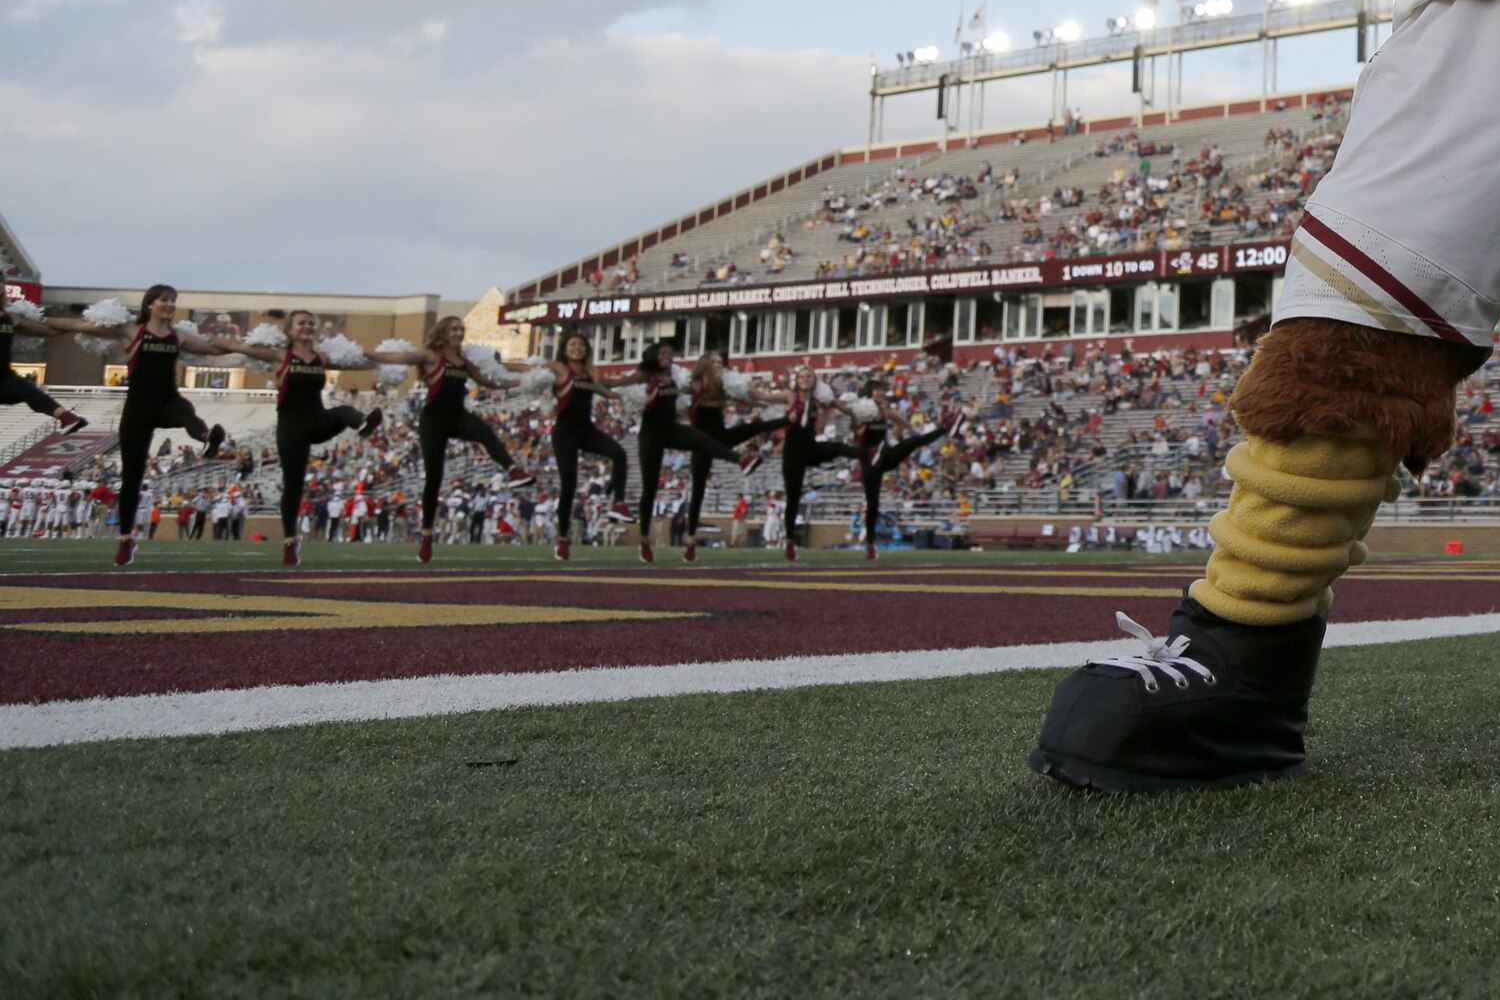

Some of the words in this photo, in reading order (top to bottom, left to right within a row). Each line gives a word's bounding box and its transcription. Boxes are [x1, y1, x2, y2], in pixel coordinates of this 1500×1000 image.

[1196, 252, 1219, 270] 45
[1235, 246, 1287, 268] 12:00
[1062, 266, 1071, 281] 1
[1105, 261, 1124, 278] 10
[1139, 259, 1154, 272] GO
[773, 284, 825, 302] CHESTNUT
[825, 281, 850, 298] HILL
[931, 270, 990, 290] COLDWELL
[991, 266, 1043, 287] BANKER,
